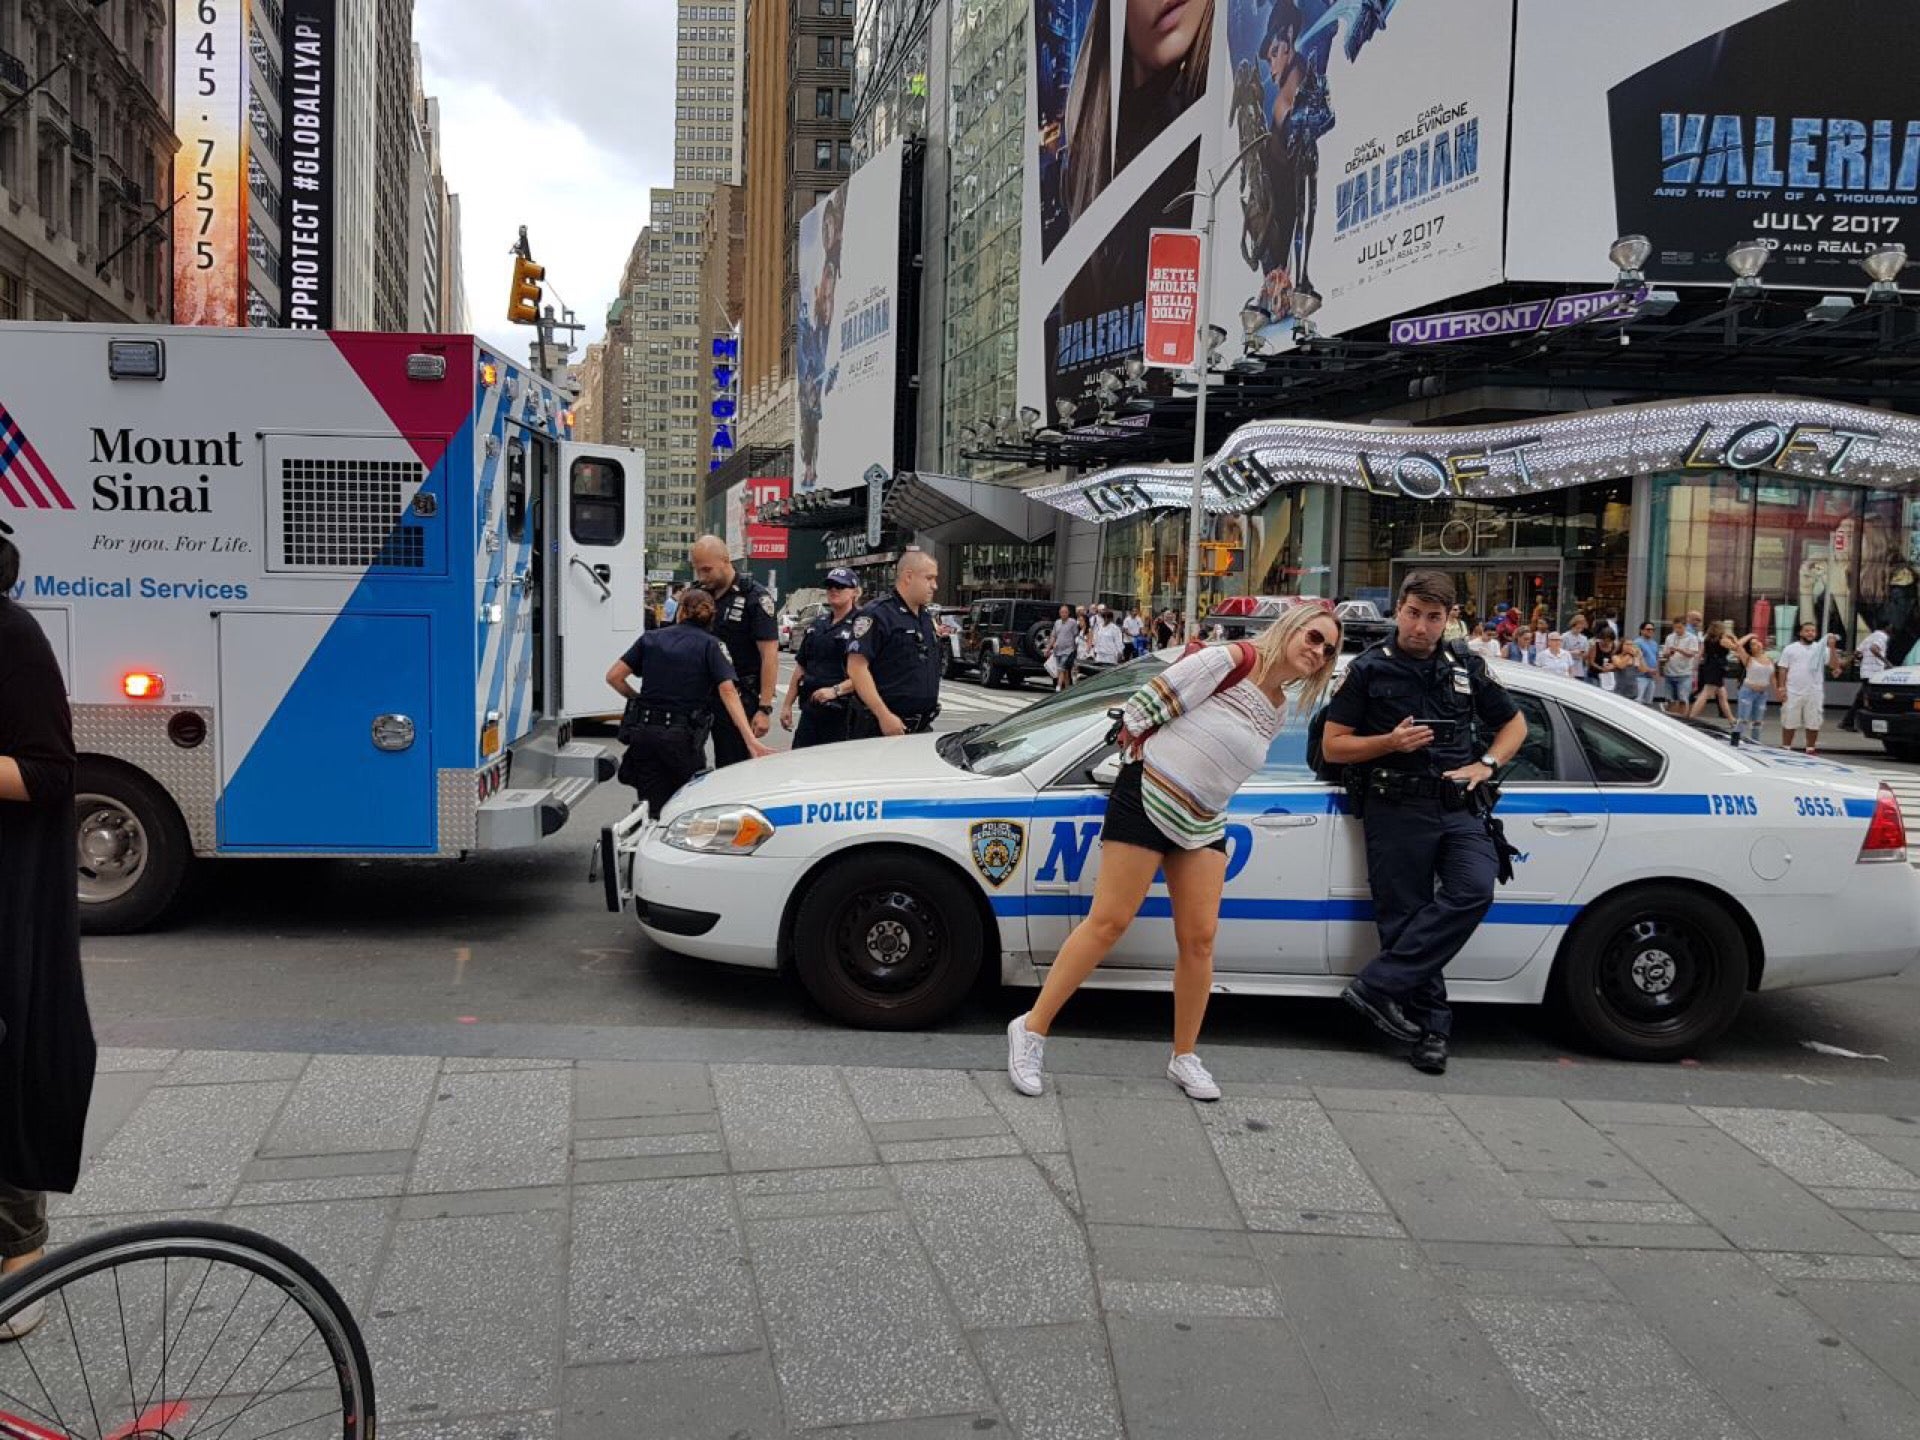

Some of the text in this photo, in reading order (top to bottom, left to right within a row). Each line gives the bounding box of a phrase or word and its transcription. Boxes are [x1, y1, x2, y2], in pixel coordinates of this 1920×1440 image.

[1417, 103, 1444, 123] CARA
[1345, 102, 1468, 174] DEHAAN DELEVINGNE
[1354, 138, 1377, 156] DANE
[1336, 117, 1478, 233] VALERIAN
[1654, 188, 1918, 205] AND THE CITY OF A THOUSAND
[1753, 212, 1900, 234] JULY 2017
[1357, 233, 1398, 264] JULY
[1402, 215, 1445, 247] 2017
[1783, 243, 1812, 252] AND
[1153, 267, 1195, 280] BETTE
[1150, 280, 1197, 293] MIDLER
[1396, 305, 1538, 343] OUTFRONT
[89, 427, 244, 467] Mount
[1681, 419, 1881, 475] LOFT
[1358, 435, 1542, 498] LOFT
[92, 472, 212, 513] Sinai
[92, 535, 252, 553] For you. For Life.
[1418, 518, 1531, 556] LOFT
[34, 575, 131, 598] Medical
[140, 577, 248, 599] Services
[806, 800, 879, 824] POLICE
[1710, 794, 1758, 816] PBMS
[1794, 795, 1834, 817] 3655
